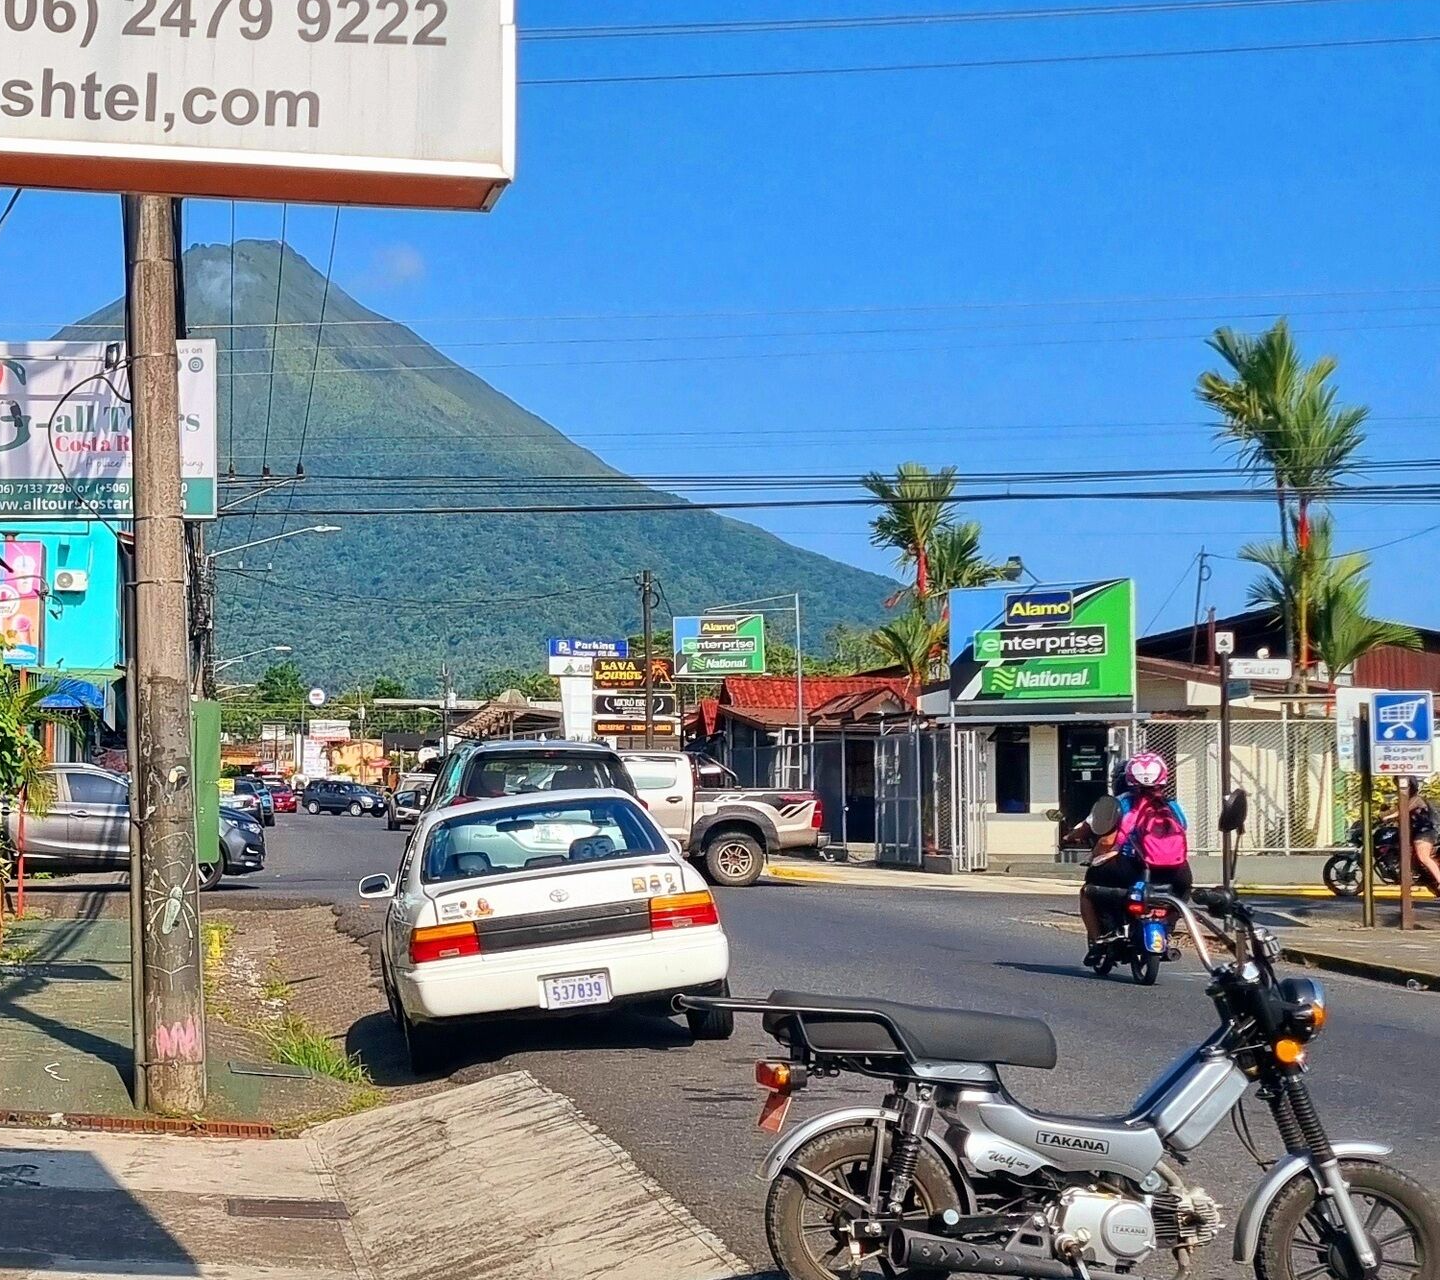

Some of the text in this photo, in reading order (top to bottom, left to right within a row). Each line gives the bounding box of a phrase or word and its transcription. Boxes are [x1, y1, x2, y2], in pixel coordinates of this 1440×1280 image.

[55, 435, 112, 453] Costa
[17, 483, 43, 494] 7133
[77, 484, 90, 494] or
[95, 483, 130, 495] (+506)
[1010, 601, 1070, 616] Alamo
[701, 622, 736, 633] Alamo
[686, 639, 754, 650] enterprise
[981, 632, 1104, 652] enterprise
[1057, 646, 1103, 655] rent-a-car
[600, 661, 636, 671] LAVA
[595, 670, 643, 680] LOUNGE
[552, 981, 602, 1001] 537839
[1039, 1132, 1106, 1152] TAKANA
[1114, 1225, 1146, 1235] TAKANA
